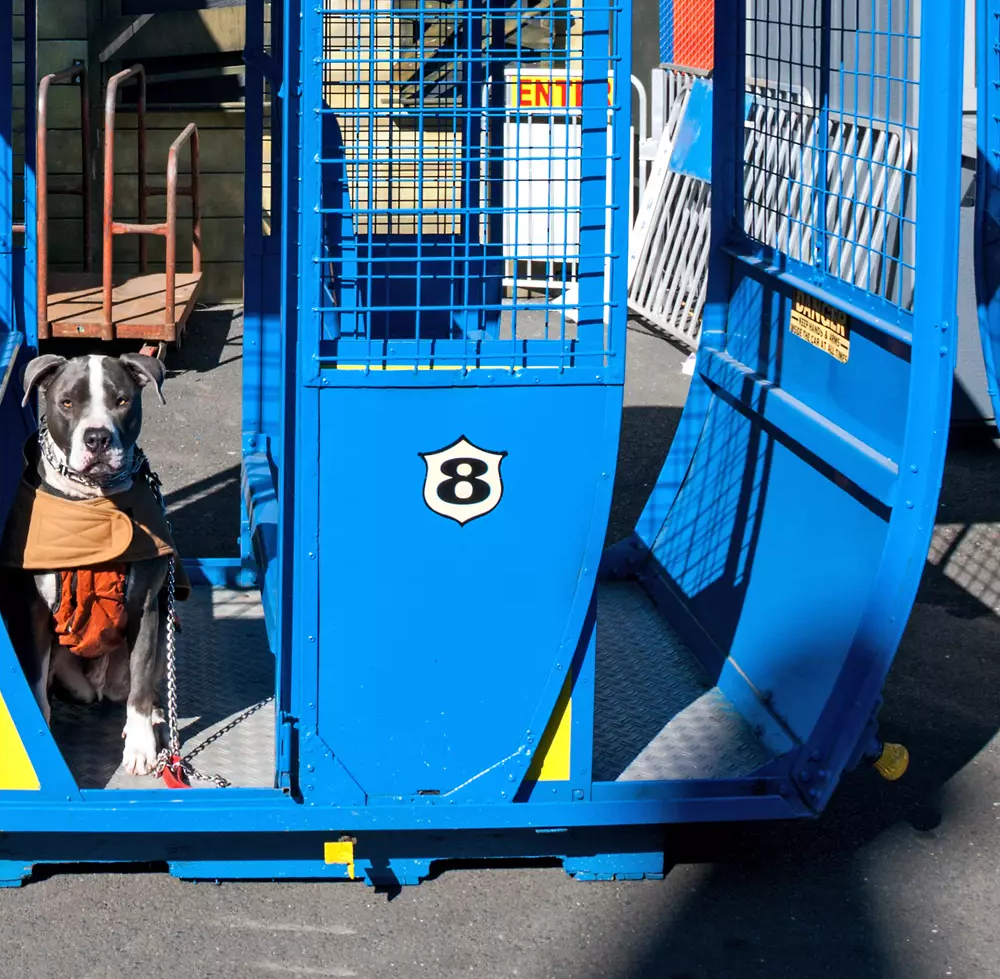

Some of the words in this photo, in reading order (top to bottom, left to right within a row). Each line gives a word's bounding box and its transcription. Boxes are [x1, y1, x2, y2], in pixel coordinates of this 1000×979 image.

[519, 79, 612, 106] ENT
[795, 290, 846, 337] DANGER
[437, 457, 490, 505] 8
